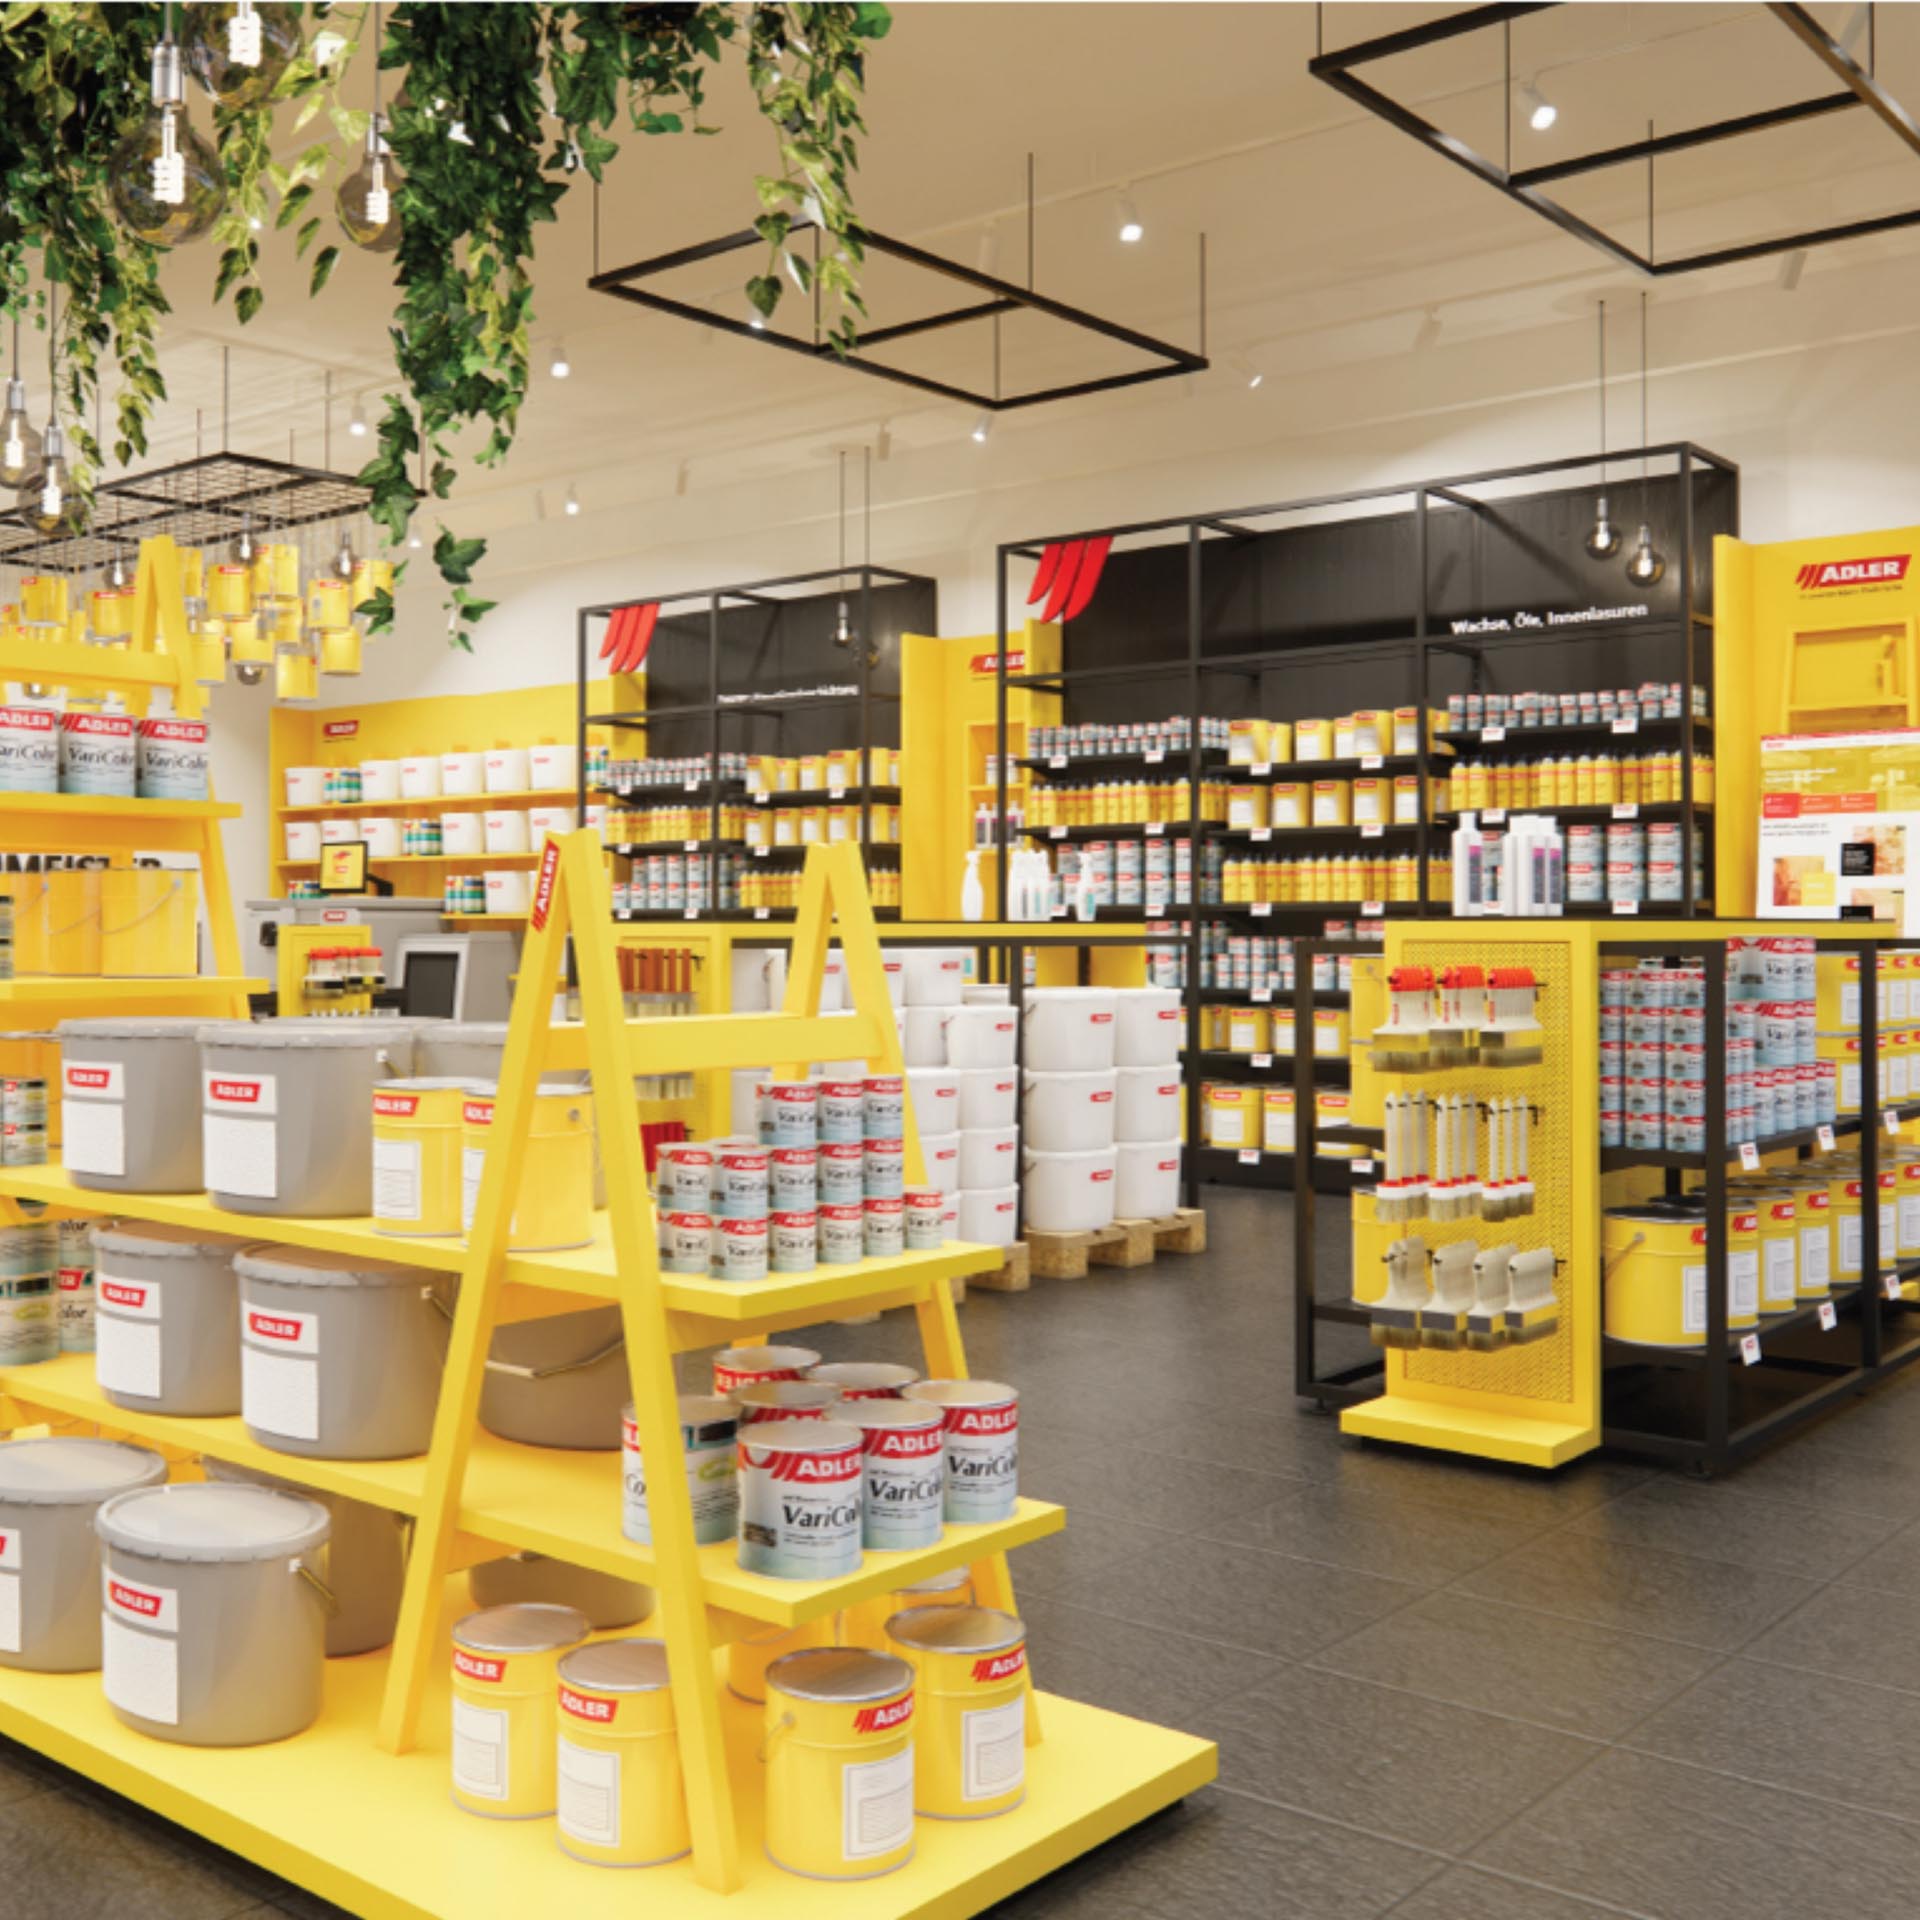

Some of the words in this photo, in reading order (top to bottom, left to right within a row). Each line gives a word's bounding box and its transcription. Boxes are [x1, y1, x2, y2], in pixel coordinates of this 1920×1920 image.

[1821, 561, 1900, 583] ADLER
[1450, 617, 1511, 634] Wachse,
[1547, 604, 1649, 625] Innenlasuren
[0, 711, 50, 727] ADLER
[77, 717, 129, 733] ADLER
[154, 723, 203, 739] ADLER
[537, 849, 557, 913] ADLER
[71, 1071, 105, 1083] ADLER
[215, 1084, 255, 1098] ADLER
[106, 1284, 141, 1303] ADLER
[255, 1317, 298, 1338] ADLER
[115, 1587, 156, 1612] ADLER
[454, 1652, 499, 1679] ADLER
[562, 1689, 610, 1719] ADLER
